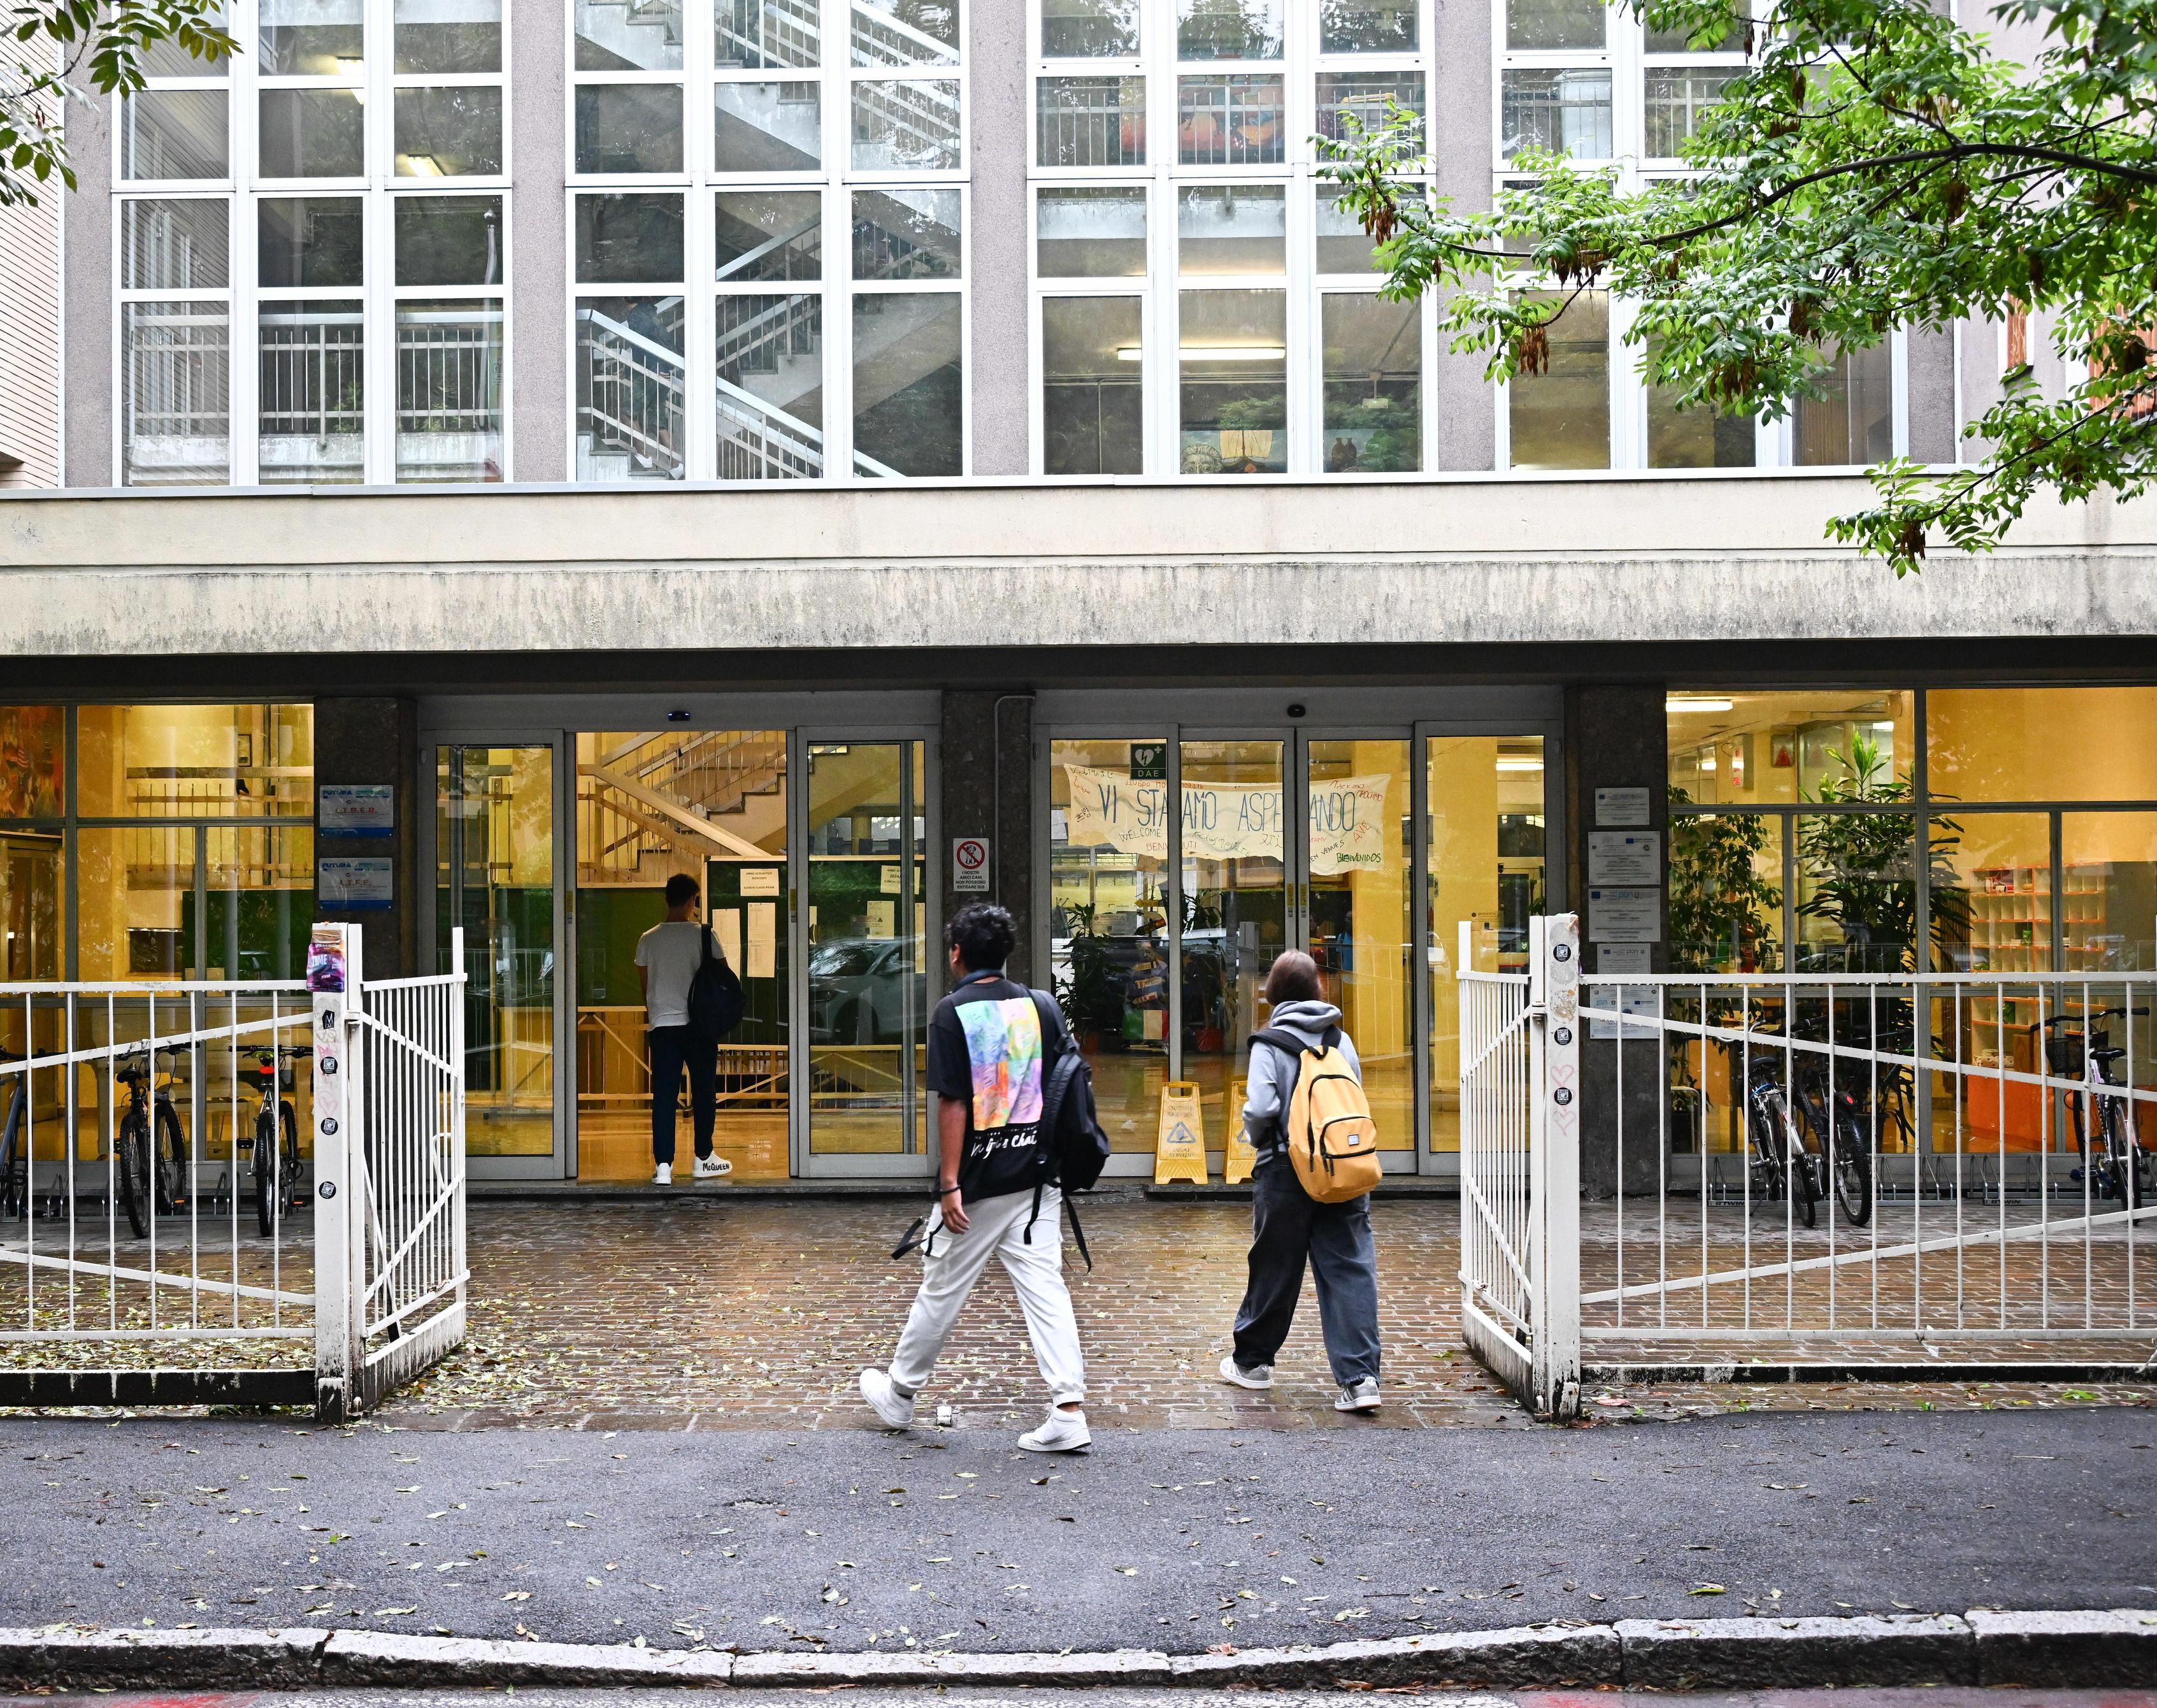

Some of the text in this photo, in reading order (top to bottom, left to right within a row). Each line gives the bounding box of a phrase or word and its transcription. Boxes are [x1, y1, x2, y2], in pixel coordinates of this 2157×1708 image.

[1098, 784, 1117, 824] VI
[1119, 828, 1161, 842] WELCOME
[1353, 819, 1372, 843] AVE
[1336, 852, 1381, 863] BIENVENIDOS
[703, 1163, 729, 1172] McQUEEN
